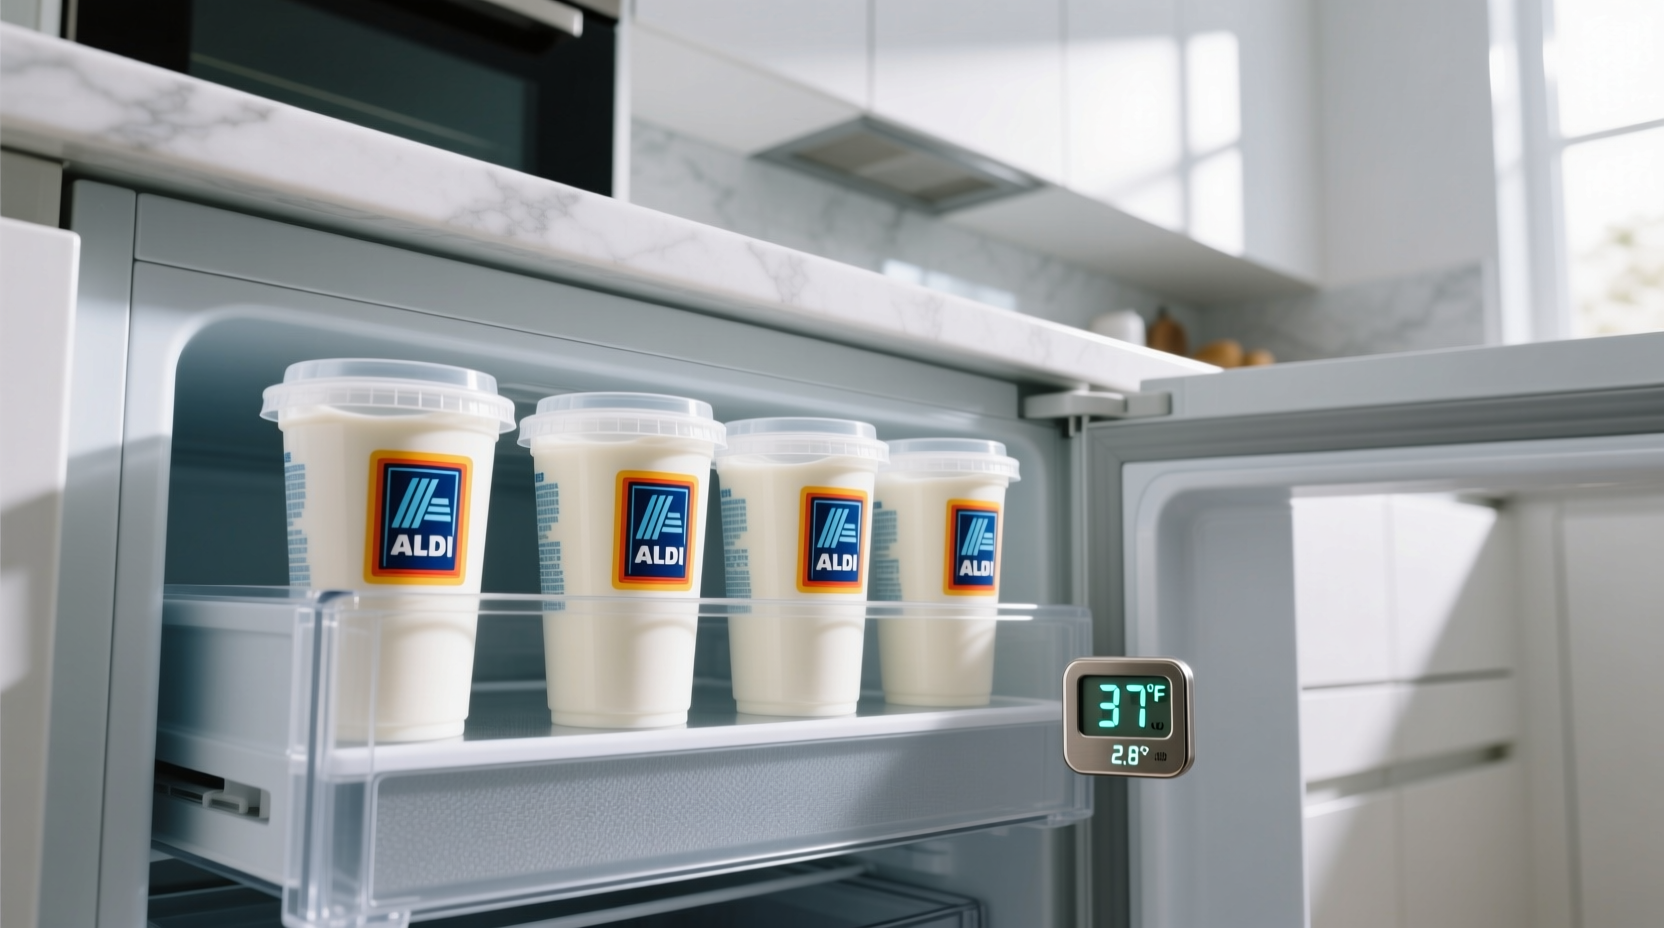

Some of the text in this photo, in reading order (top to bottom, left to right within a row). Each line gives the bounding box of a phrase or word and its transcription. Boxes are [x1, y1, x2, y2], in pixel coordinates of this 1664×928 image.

[390, 534, 454, 558] ALDI
[634, 545, 684, 566] ALDI
[815, 553, 858, 572] ALDI
[959, 559, 994, 577] ALDI
